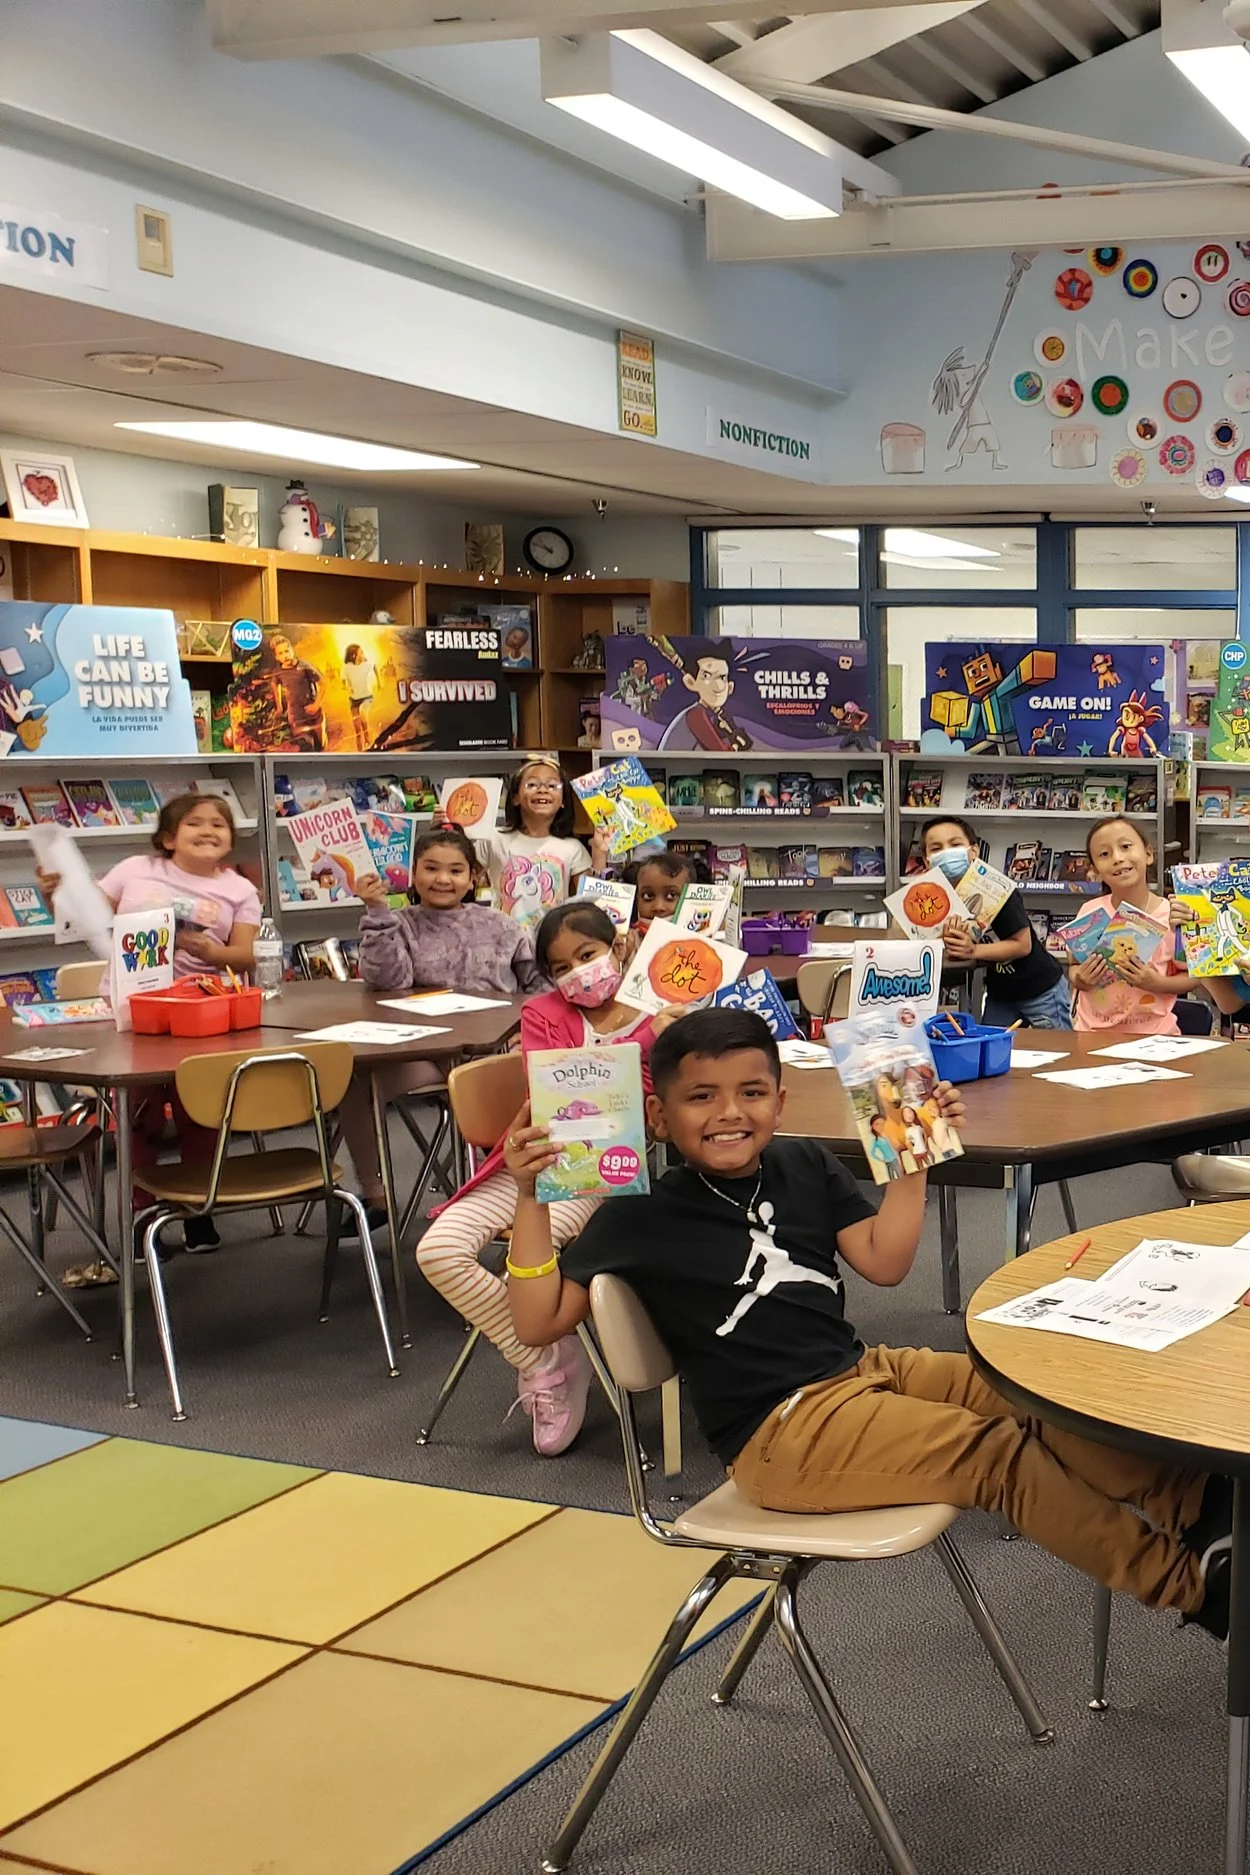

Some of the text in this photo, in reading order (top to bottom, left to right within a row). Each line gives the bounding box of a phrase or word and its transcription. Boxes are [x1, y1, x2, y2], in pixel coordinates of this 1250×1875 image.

[0, 221, 76, 267] ION
[1074, 317, 1235, 378] Make
[720, 419, 810, 460] NONFICTION
[93, 634, 145, 658] LIFE
[425, 630, 498, 650] FEARLESS
[1224, 650, 1244, 663] CHP
[74, 660, 169, 683] CAN BE
[753, 670, 829, 685] CHILLS &
[78, 686, 170, 709] FUNNY
[399, 682, 497, 702] I SURVIVED
[758, 685, 827, 699] THRILLS
[1028, 696, 1112, 710] GAME ON!
[774, 807, 801, 815] READS
[321, 821, 360, 847] CLUB
[1183, 867, 1218, 880] Pete
[1026, 882, 1065, 890] NEIGHBOR
[163, 913, 170, 924] 3
[122, 927, 170, 953] GOOD
[678, 949, 702, 971] the
[865, 946, 875, 959] 2
[660, 964, 707, 994] dot
[862, 951, 931, 1000] Awesome!
[552, 1062, 612, 1083] Dolphin
